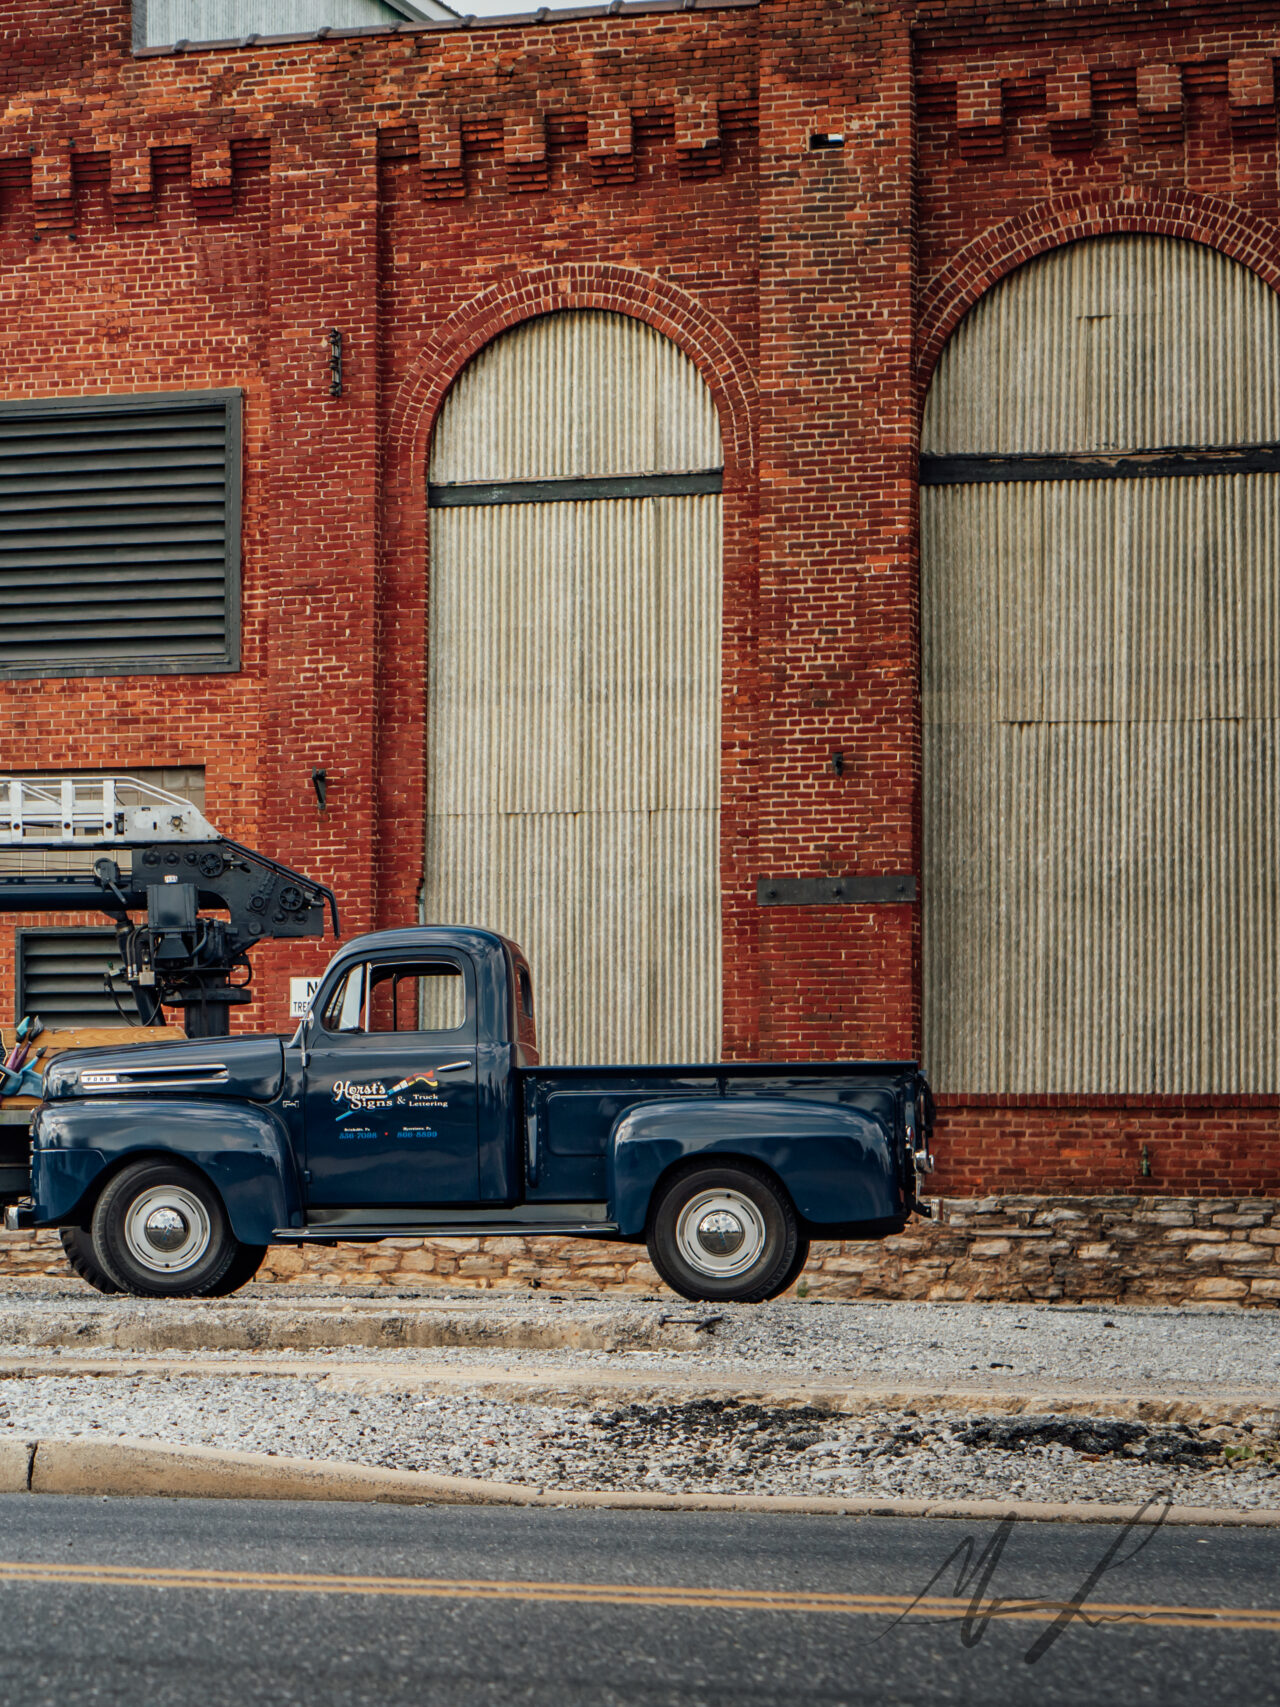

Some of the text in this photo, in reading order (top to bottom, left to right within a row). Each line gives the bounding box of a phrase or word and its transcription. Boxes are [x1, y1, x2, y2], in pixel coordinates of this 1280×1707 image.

[333, 1080, 386, 1101] Horst's
[350, 1093, 406, 1109] Signs &
